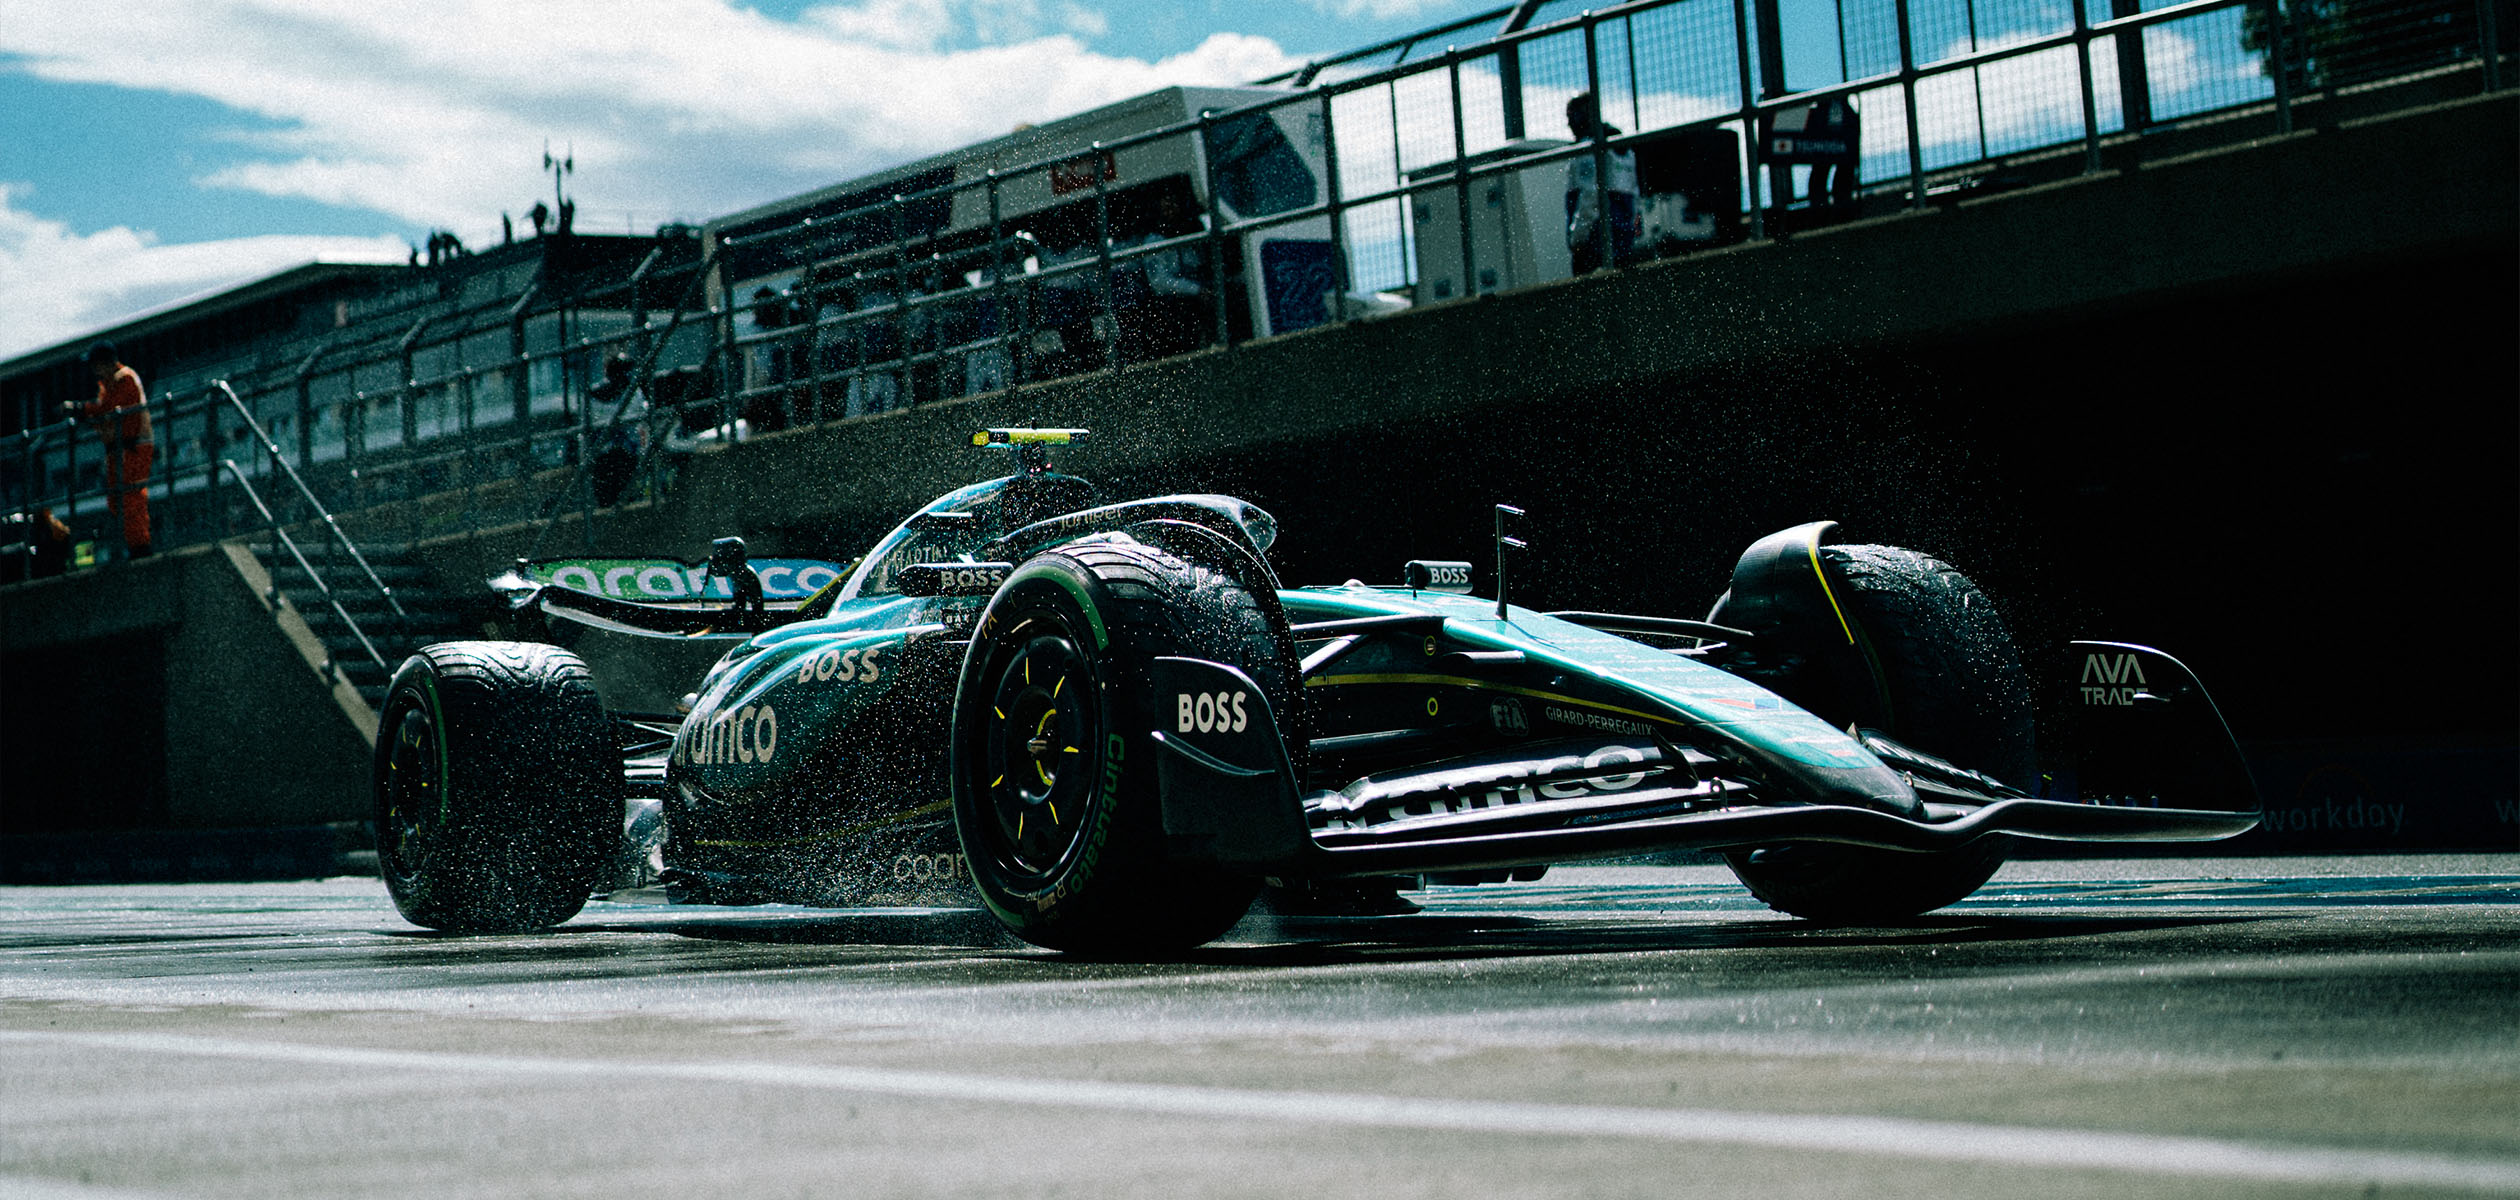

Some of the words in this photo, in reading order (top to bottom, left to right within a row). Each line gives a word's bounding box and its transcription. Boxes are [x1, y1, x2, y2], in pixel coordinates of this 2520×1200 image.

[941, 569, 1003, 588] BOSS
[1429, 567, 1469, 584] BOSS
[797, 649, 880, 684] BOSS
[2081, 653, 2147, 684] AVA
[1178, 690, 1248, 734] BOSS
[1492, 704, 1527, 730] FIA
[1545, 706, 1653, 736] GIRARD-PERREGAUX
[1327, 745, 1646, 831] amco
[2262, 795, 2408, 841] workday
